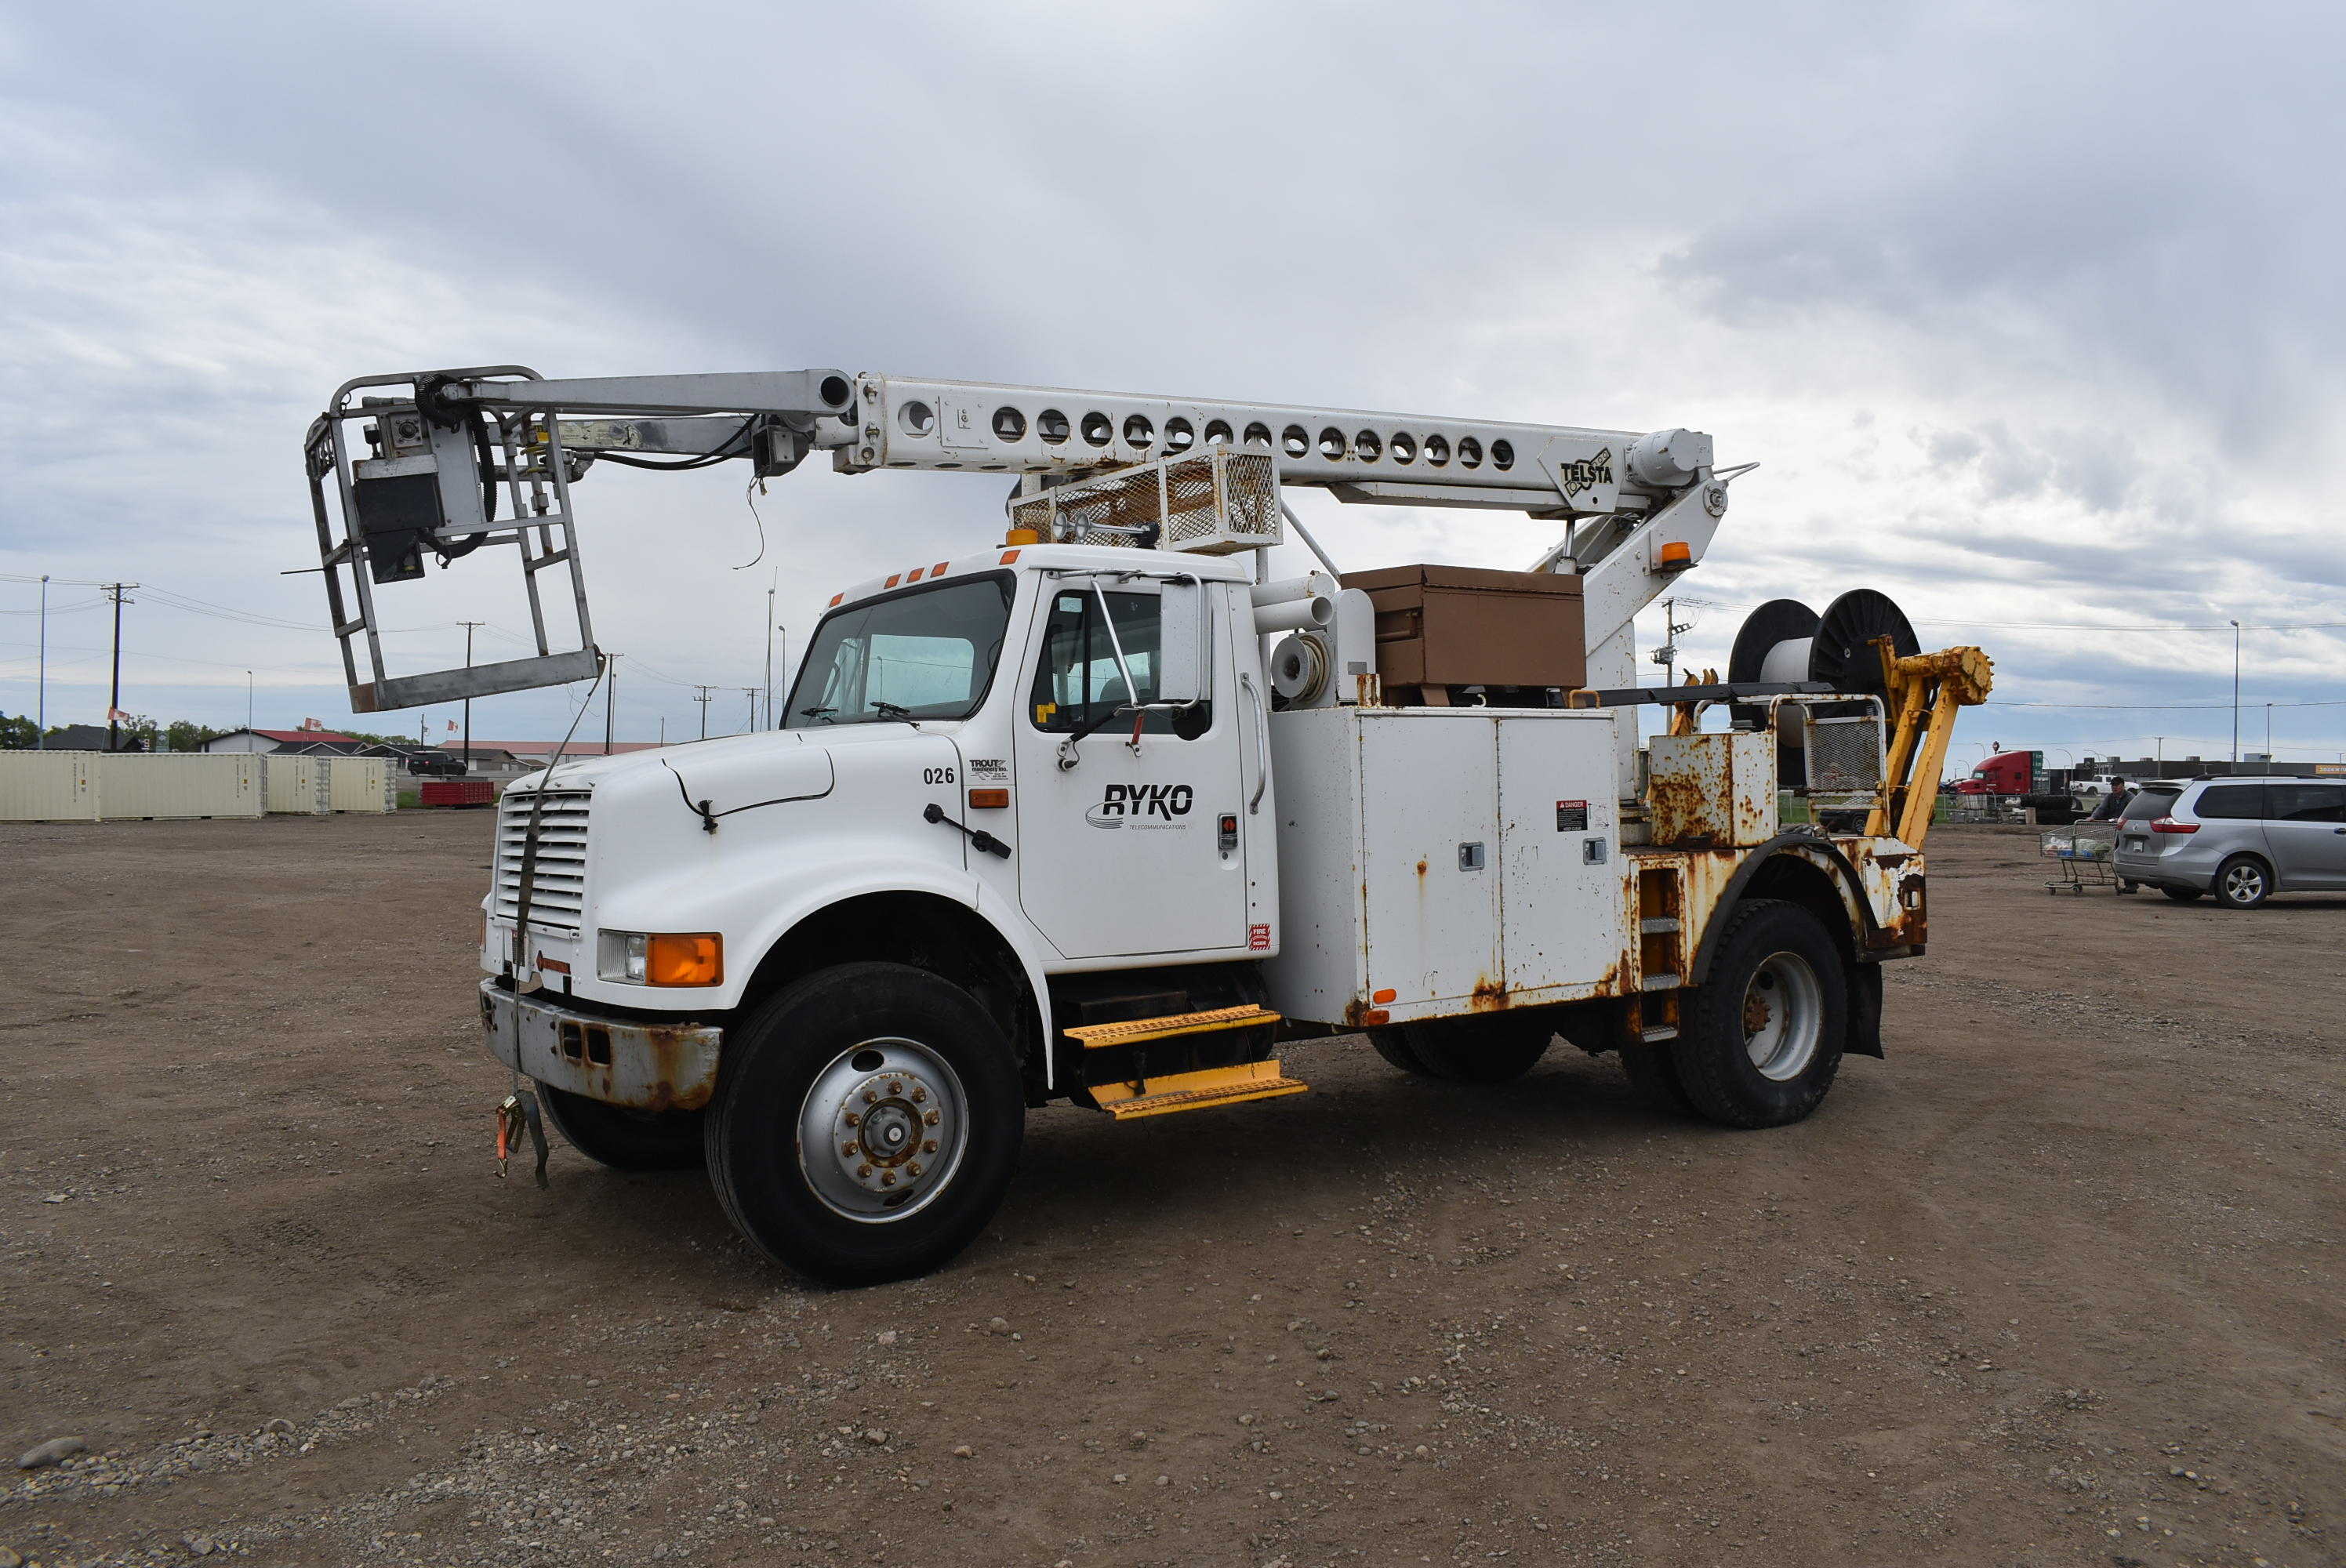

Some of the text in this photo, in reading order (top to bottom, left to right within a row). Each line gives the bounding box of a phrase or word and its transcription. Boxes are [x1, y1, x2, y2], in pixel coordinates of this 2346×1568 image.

[1560, 463, 1613, 484] TELSTA
[924, 768, 954, 785] 026
[1102, 784, 1193, 821] RYKO
